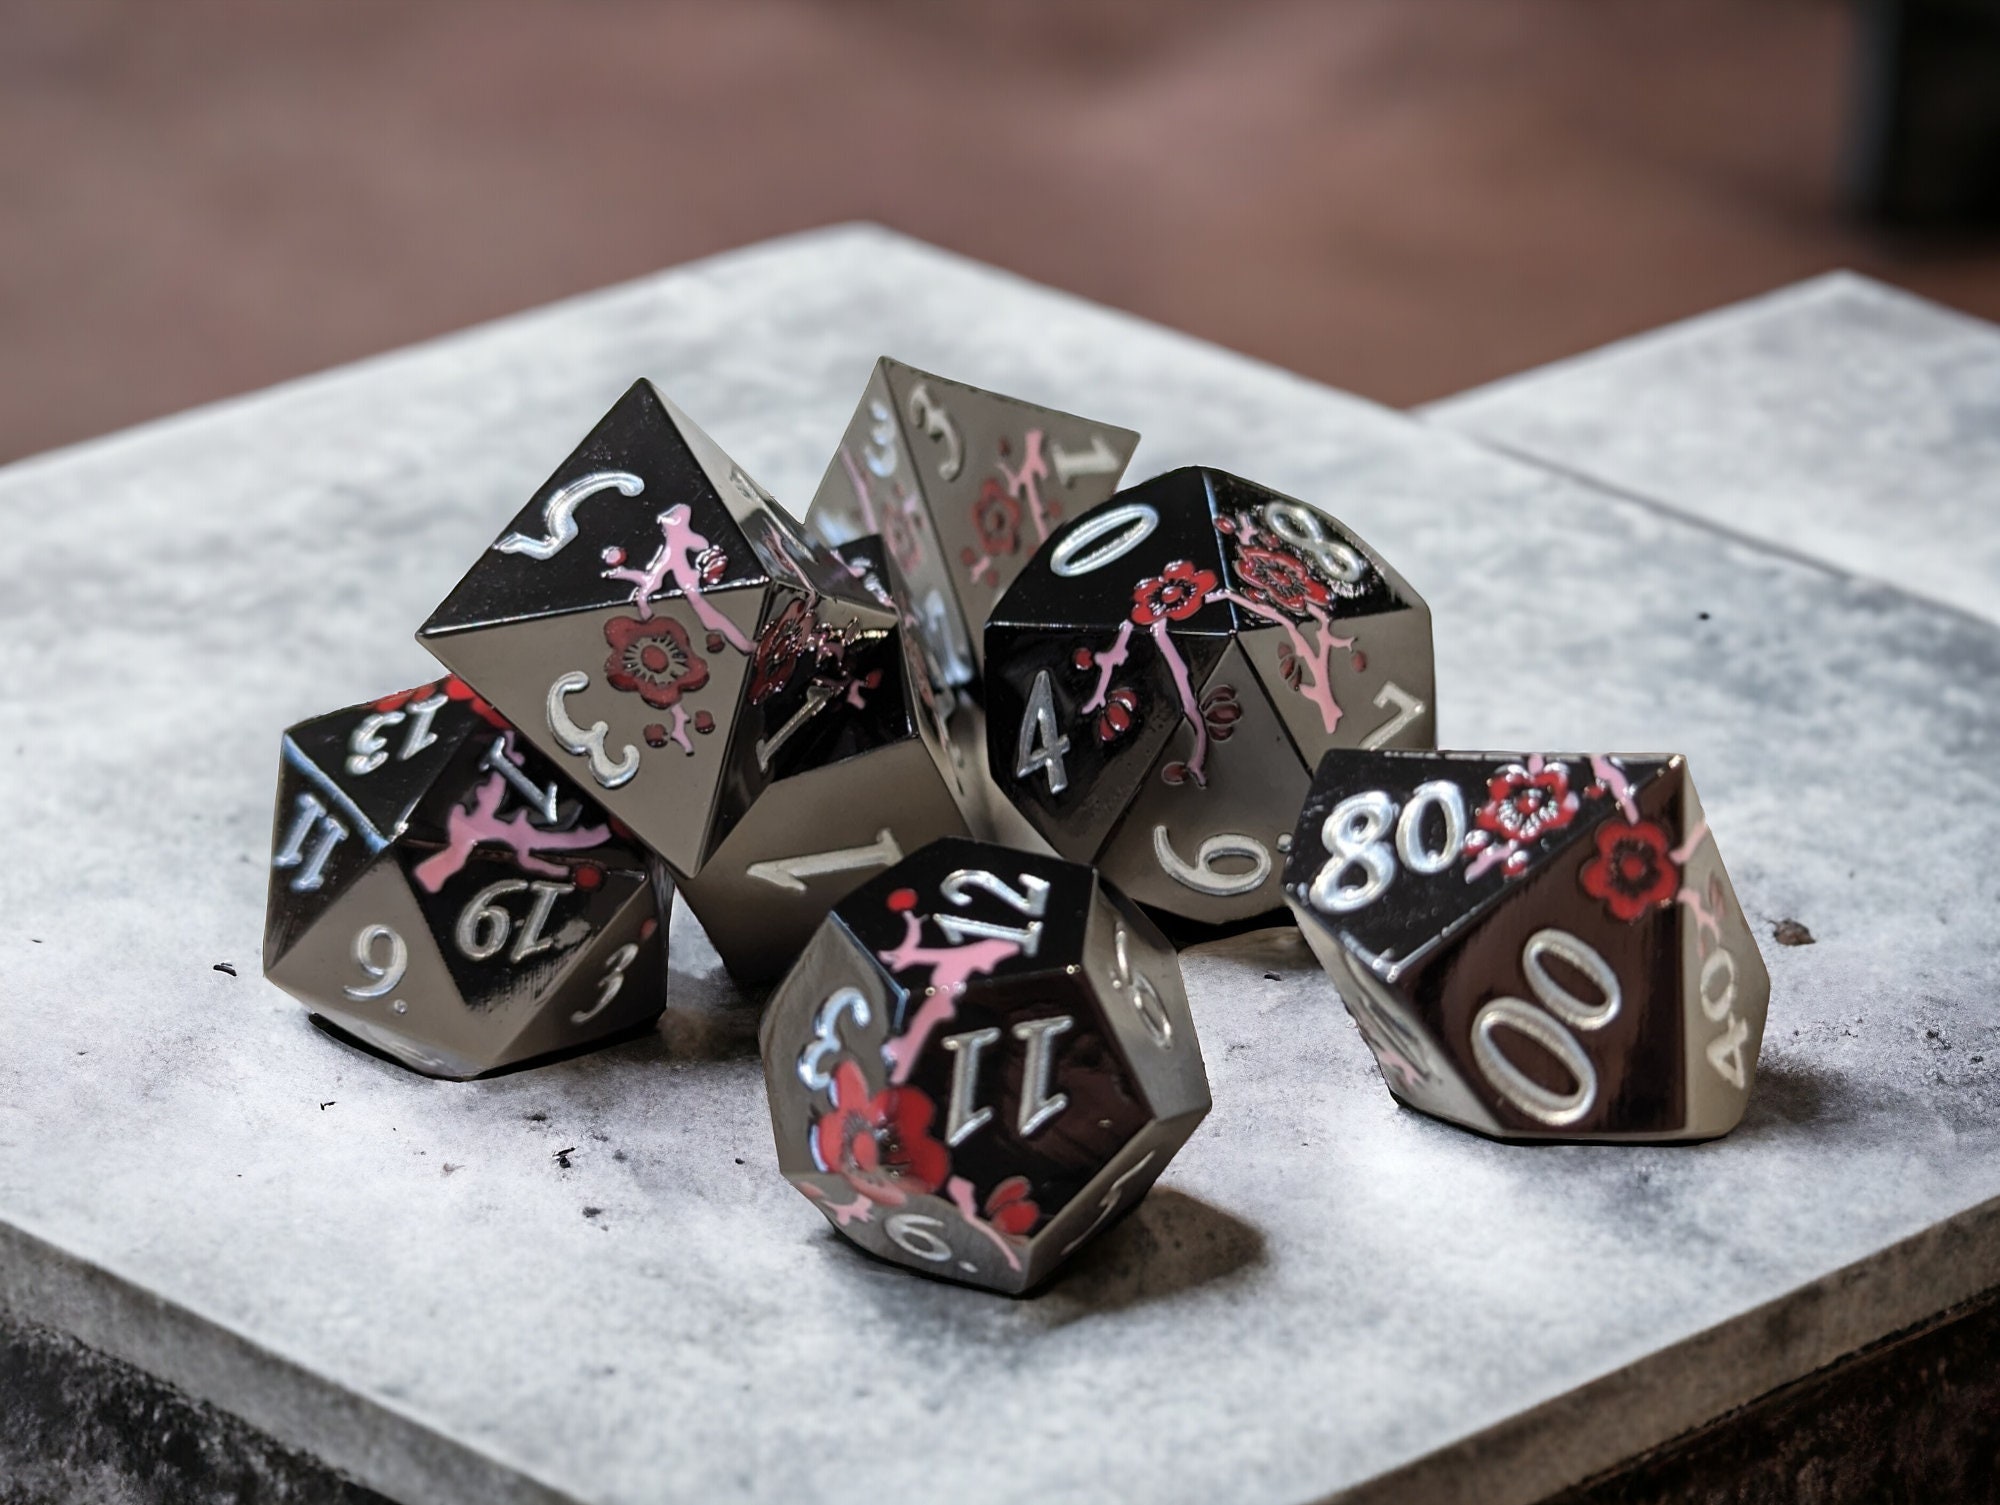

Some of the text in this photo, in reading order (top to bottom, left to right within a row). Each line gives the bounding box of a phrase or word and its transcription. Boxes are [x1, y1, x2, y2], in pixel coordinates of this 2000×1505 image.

[1052, 434, 1121, 488] 1
[1049, 503, 1160, 578] 0
[1265, 501, 1364, 583] 8
[346, 694, 448, 775] 13
[546, 670, 640, 789] 3
[1016, 669, 1070, 795] 4
[478, 736, 558, 823] 1
[272, 793, 349, 891] 11
[746, 827, 904, 892] 1
[1308, 779, 1467, 914] 80
[932, 869, 1052, 958] 12
[570, 943, 639, 1025] 3
[1471, 927, 1622, 1127] 00
[1700, 947, 1749, 1090] 40
[797, 987, 871, 1092] 3
[942, 1014, 1074, 1148] 11
